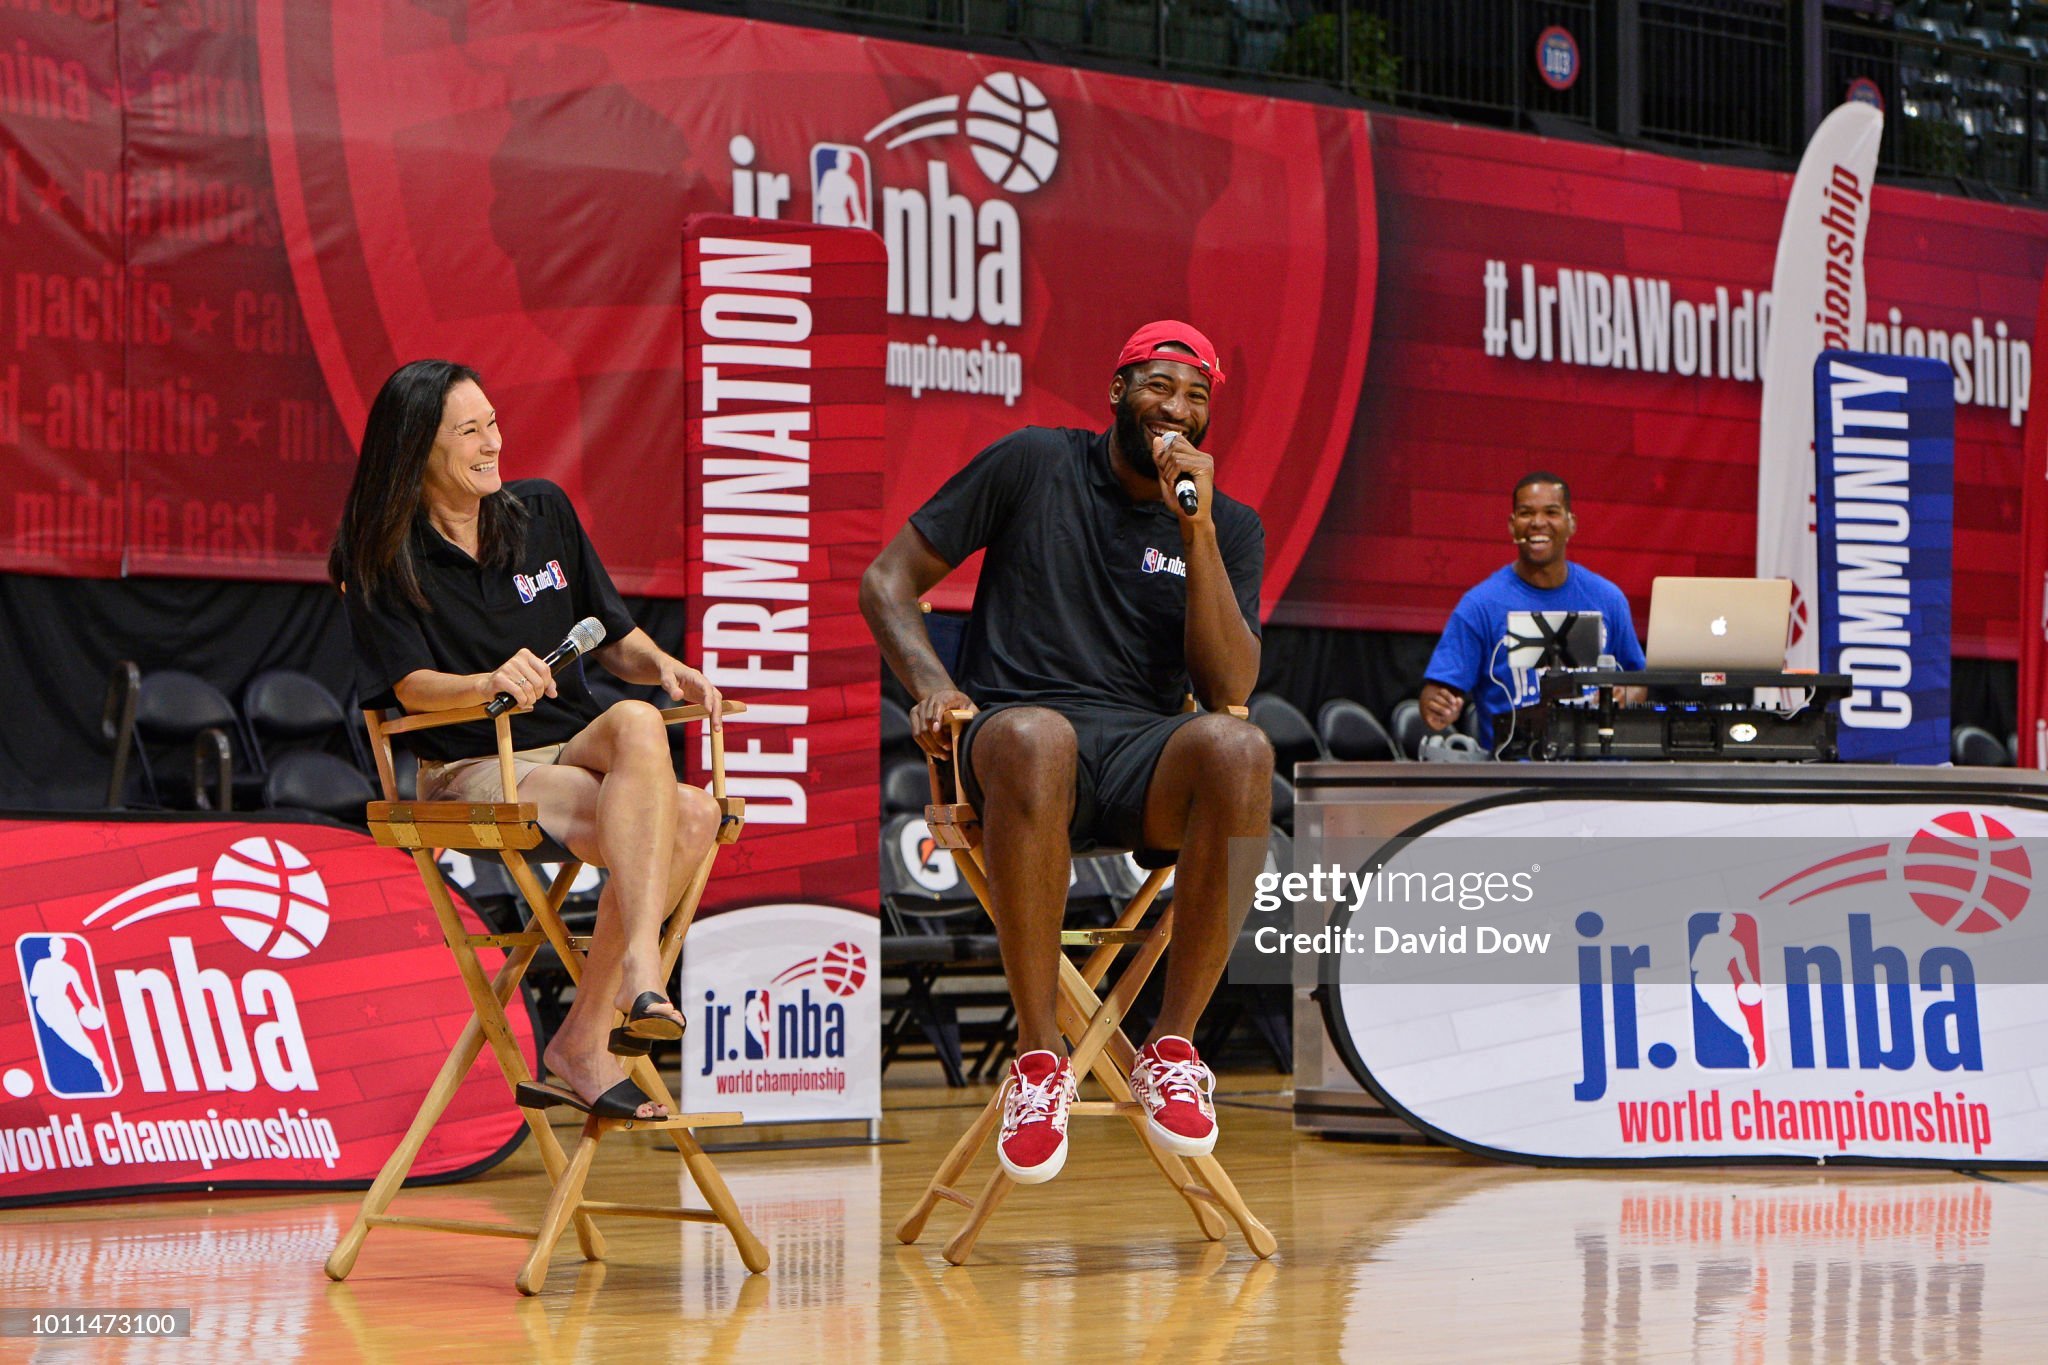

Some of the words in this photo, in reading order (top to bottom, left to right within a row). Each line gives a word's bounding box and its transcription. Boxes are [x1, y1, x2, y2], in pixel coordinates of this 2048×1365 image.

[883, 159, 1021, 326] nba
[700, 236, 814, 825] DETERMINATION
[1829, 360, 1912, 730] COMMUNITY
[114, 936, 319, 1093] nba
[701, 990, 738, 1076] jr.
[778, 988, 845, 1059] nba
[716, 1070, 753, 1094] world
[756, 1067, 845, 1095] championship
[1574, 911, 1677, 1102] jr.
[1784, 913, 1984, 1072] nba
[94, 1108, 341, 1170] championship
[1618, 1090, 1722, 1143] world
[1731, 1090, 1992, 1154] championship
